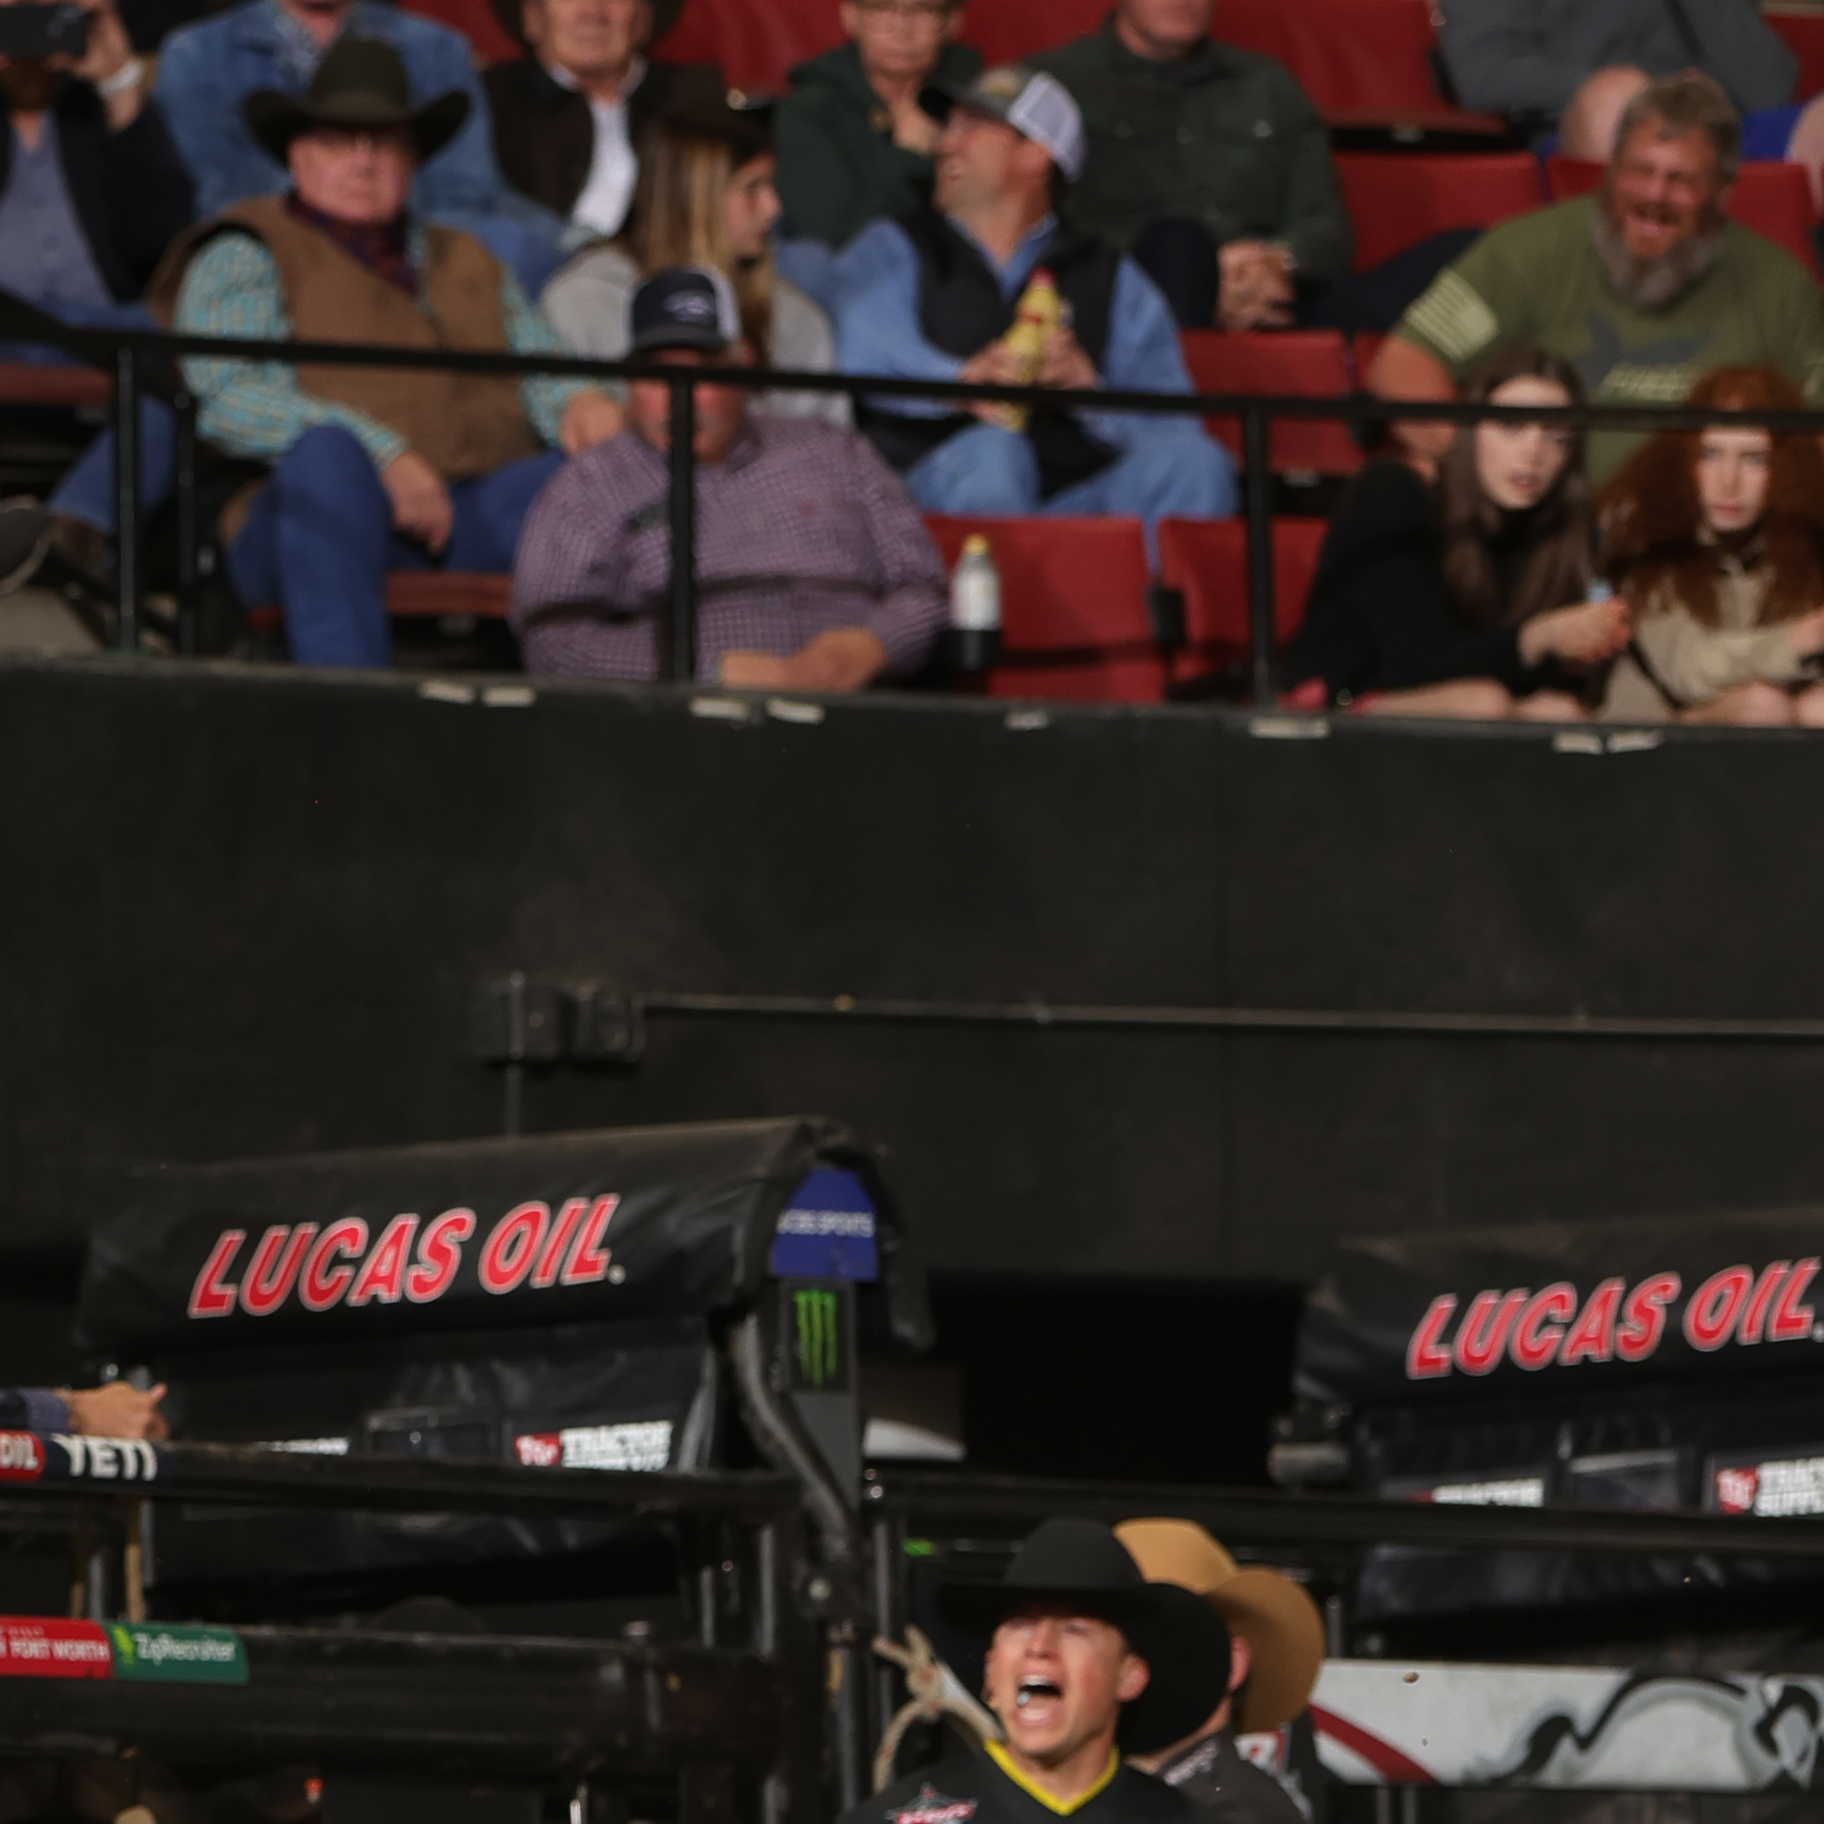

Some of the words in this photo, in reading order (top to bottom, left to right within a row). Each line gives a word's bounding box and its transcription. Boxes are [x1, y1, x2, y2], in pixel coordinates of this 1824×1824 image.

[187, 1207, 477, 1319] LUCAS
[1406, 1271, 1682, 1380] LUCAS
[52, 1432, 158, 1480] YETI
